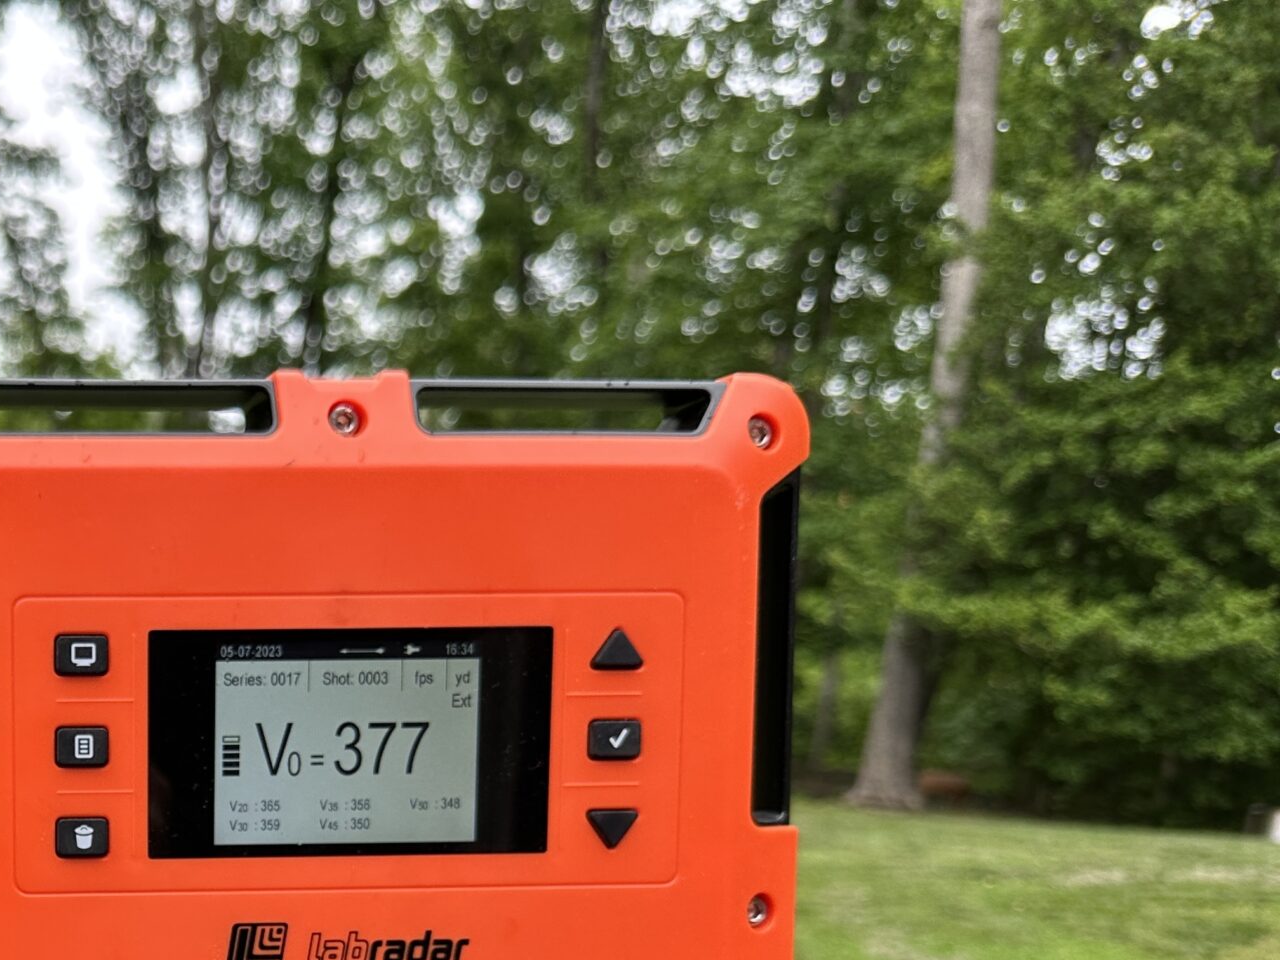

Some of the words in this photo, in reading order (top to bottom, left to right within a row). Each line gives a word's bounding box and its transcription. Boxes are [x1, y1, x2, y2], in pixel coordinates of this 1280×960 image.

[220, 645, 282, 658] 05-07-2023
[445, 644, 474, 656] 16:34
[223, 673, 267, 686] Series:
[270, 672, 301, 686] 0017
[322, 672, 354, 686] Shot:
[358, 671, 389, 686] 0003
[415, 670, 434, 688] fps
[455, 670, 471, 687] yd
[452, 694, 472, 708] Ext
[334, 721, 430, 776] 377
